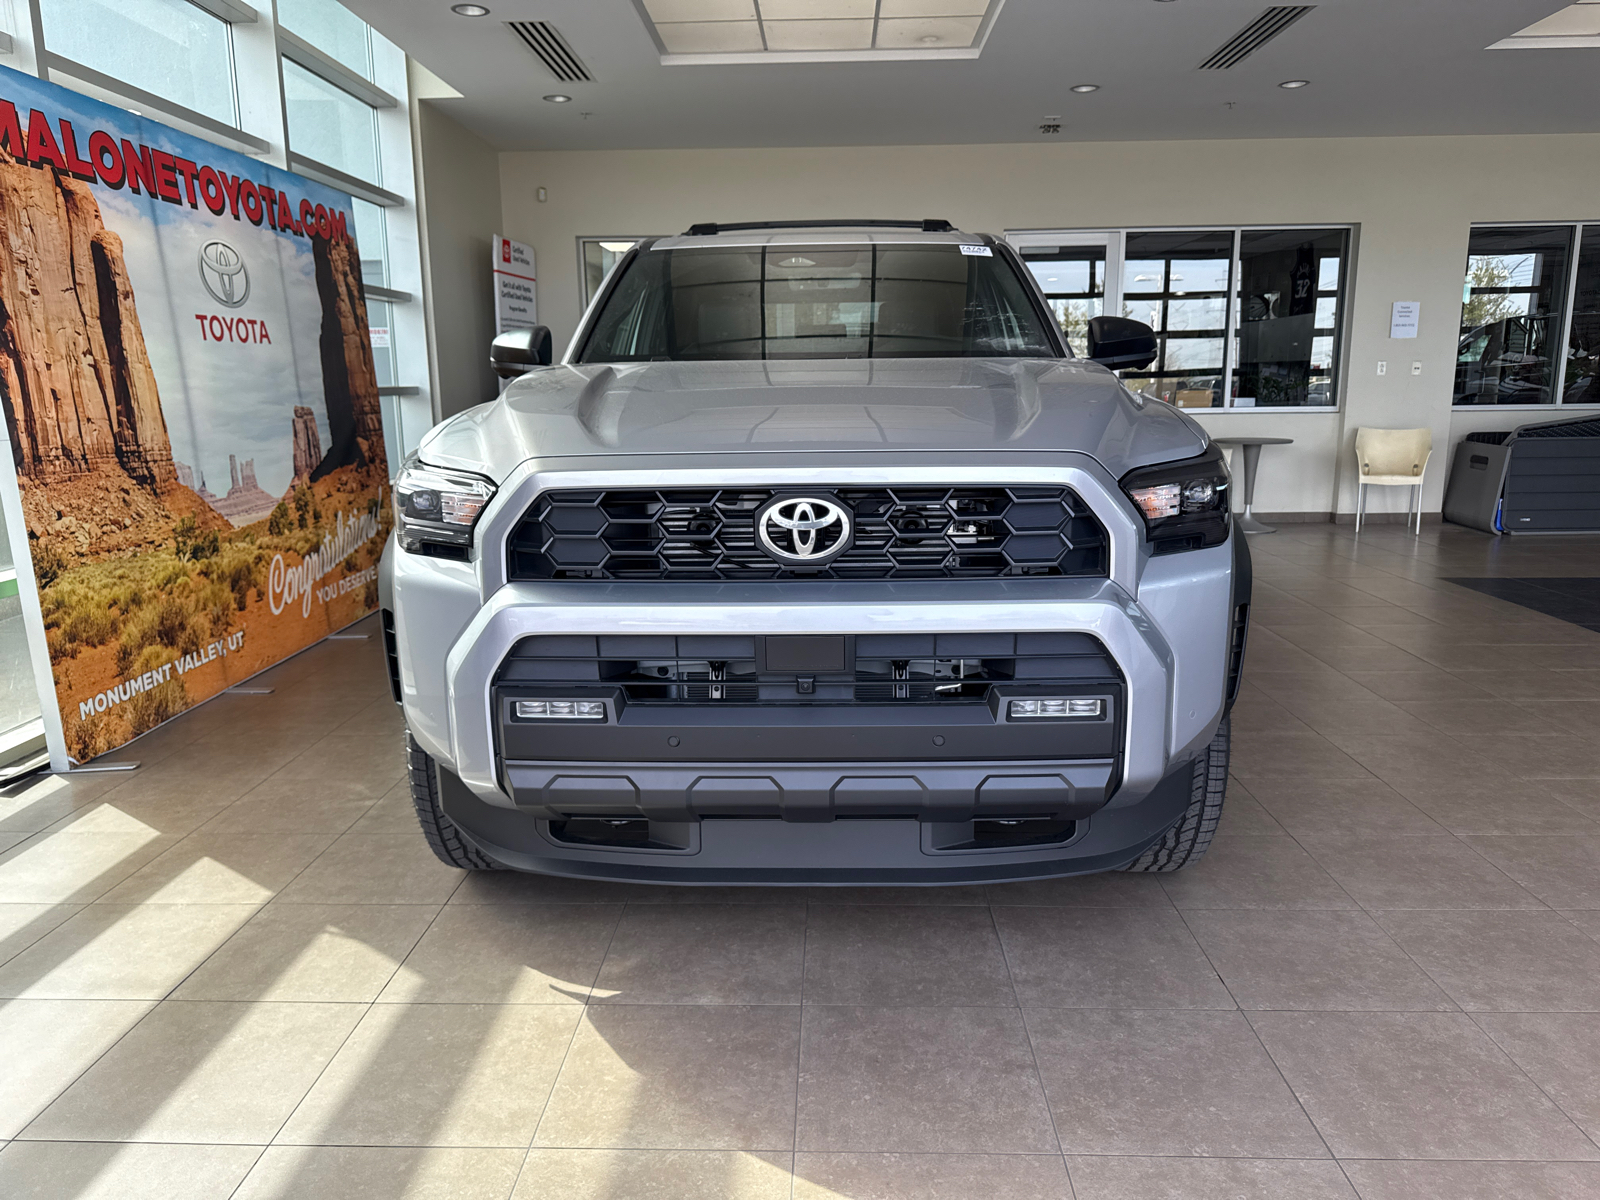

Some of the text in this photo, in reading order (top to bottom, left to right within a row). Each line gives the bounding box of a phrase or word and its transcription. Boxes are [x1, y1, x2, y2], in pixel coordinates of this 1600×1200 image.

[195, 314, 271, 344] TOYOTA
[269, 485, 382, 618] Congratulations!
[316, 566, 378, 604] YOU DESERVE
[79, 631, 244, 721] MONUMENT VALLEY, UT
